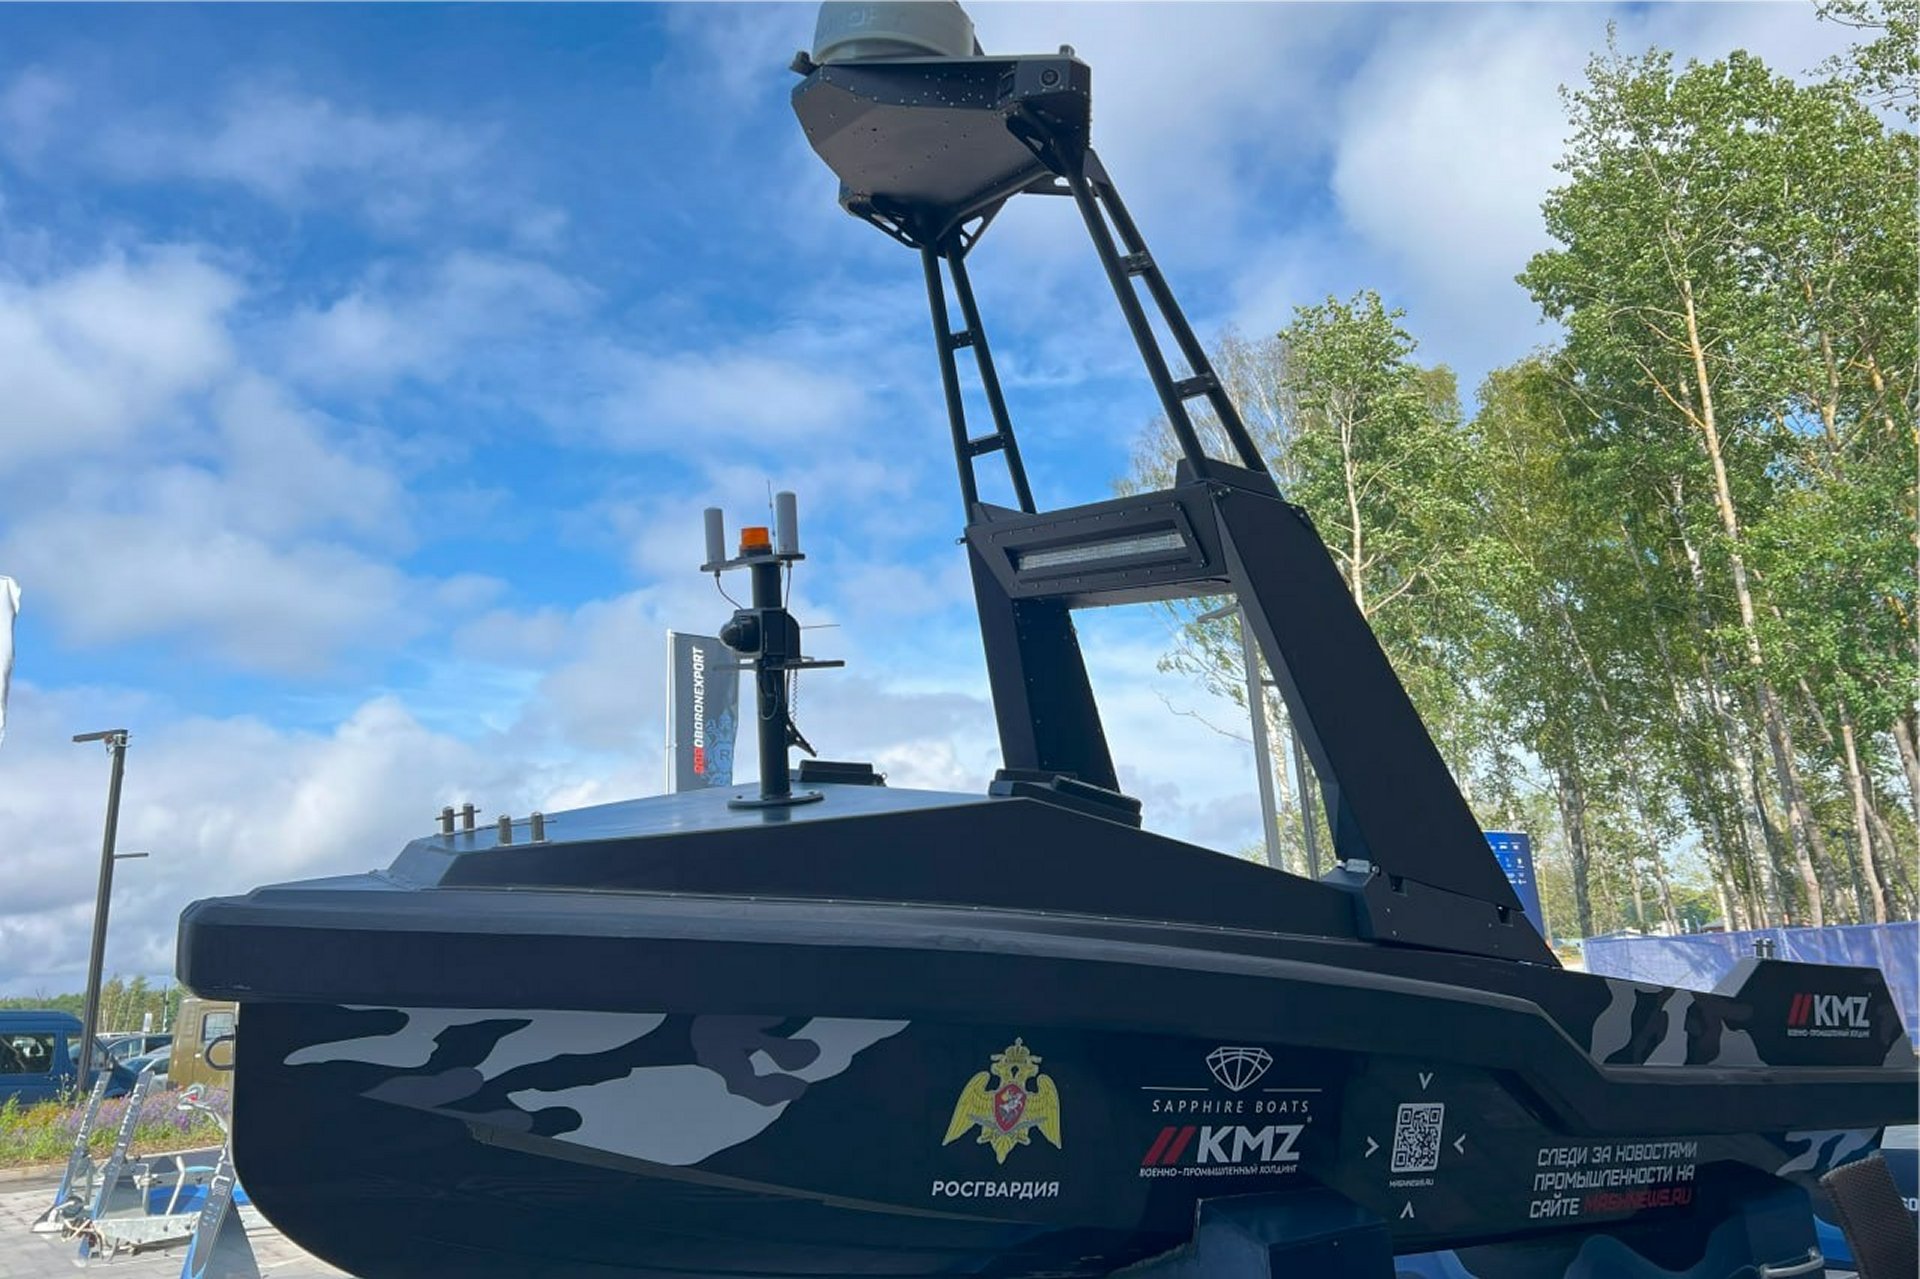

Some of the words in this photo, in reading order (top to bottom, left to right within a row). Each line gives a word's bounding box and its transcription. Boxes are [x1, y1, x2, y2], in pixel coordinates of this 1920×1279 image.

[1813, 994, 1870, 1027] KMZ
[1152, 1099, 1244, 1114] SAPPHIRE
[1255, 1100, 1309, 1114] BOATS
[1197, 1124, 1305, 1163] KMZ
[1537, 1147, 1588, 1169] СЛЕДИ
[1592, 1146, 1612, 1164] ЗА
[1615, 1142, 1697, 1162] НОВОСТЯМИ
[931, 1180, 1060, 1199] РОСГВАРДИЯ
[1534, 1167, 1672, 1191] ПРОМЫШЛЕННОСТИ
[1676, 1163, 1696, 1182] НА
[1529, 1192, 1581, 1218] САЙТЕ
